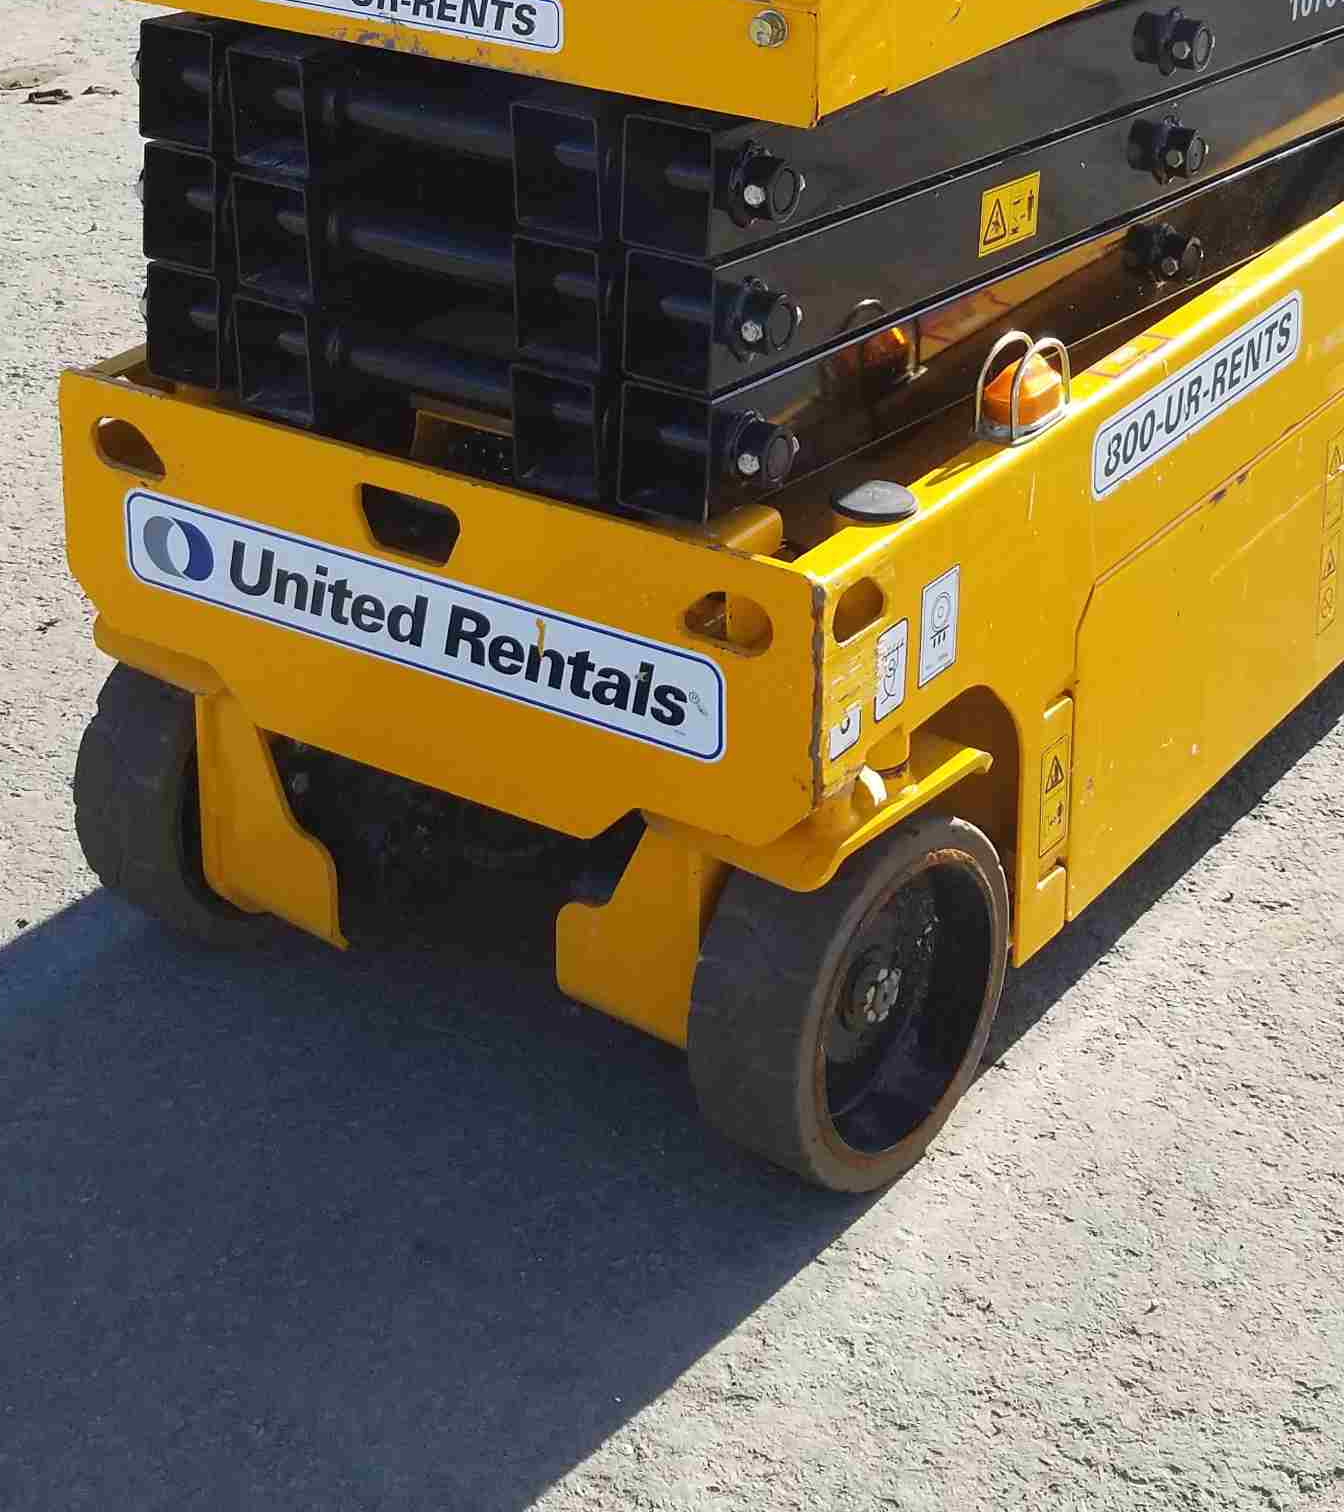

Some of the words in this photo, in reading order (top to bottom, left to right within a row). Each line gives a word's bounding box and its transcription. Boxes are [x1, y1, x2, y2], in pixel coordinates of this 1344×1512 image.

[1102, 310, 1293, 478] 800-UR-RENTS
[229, 539, 426, 649] United
[443, 604, 688, 727] Rentals
